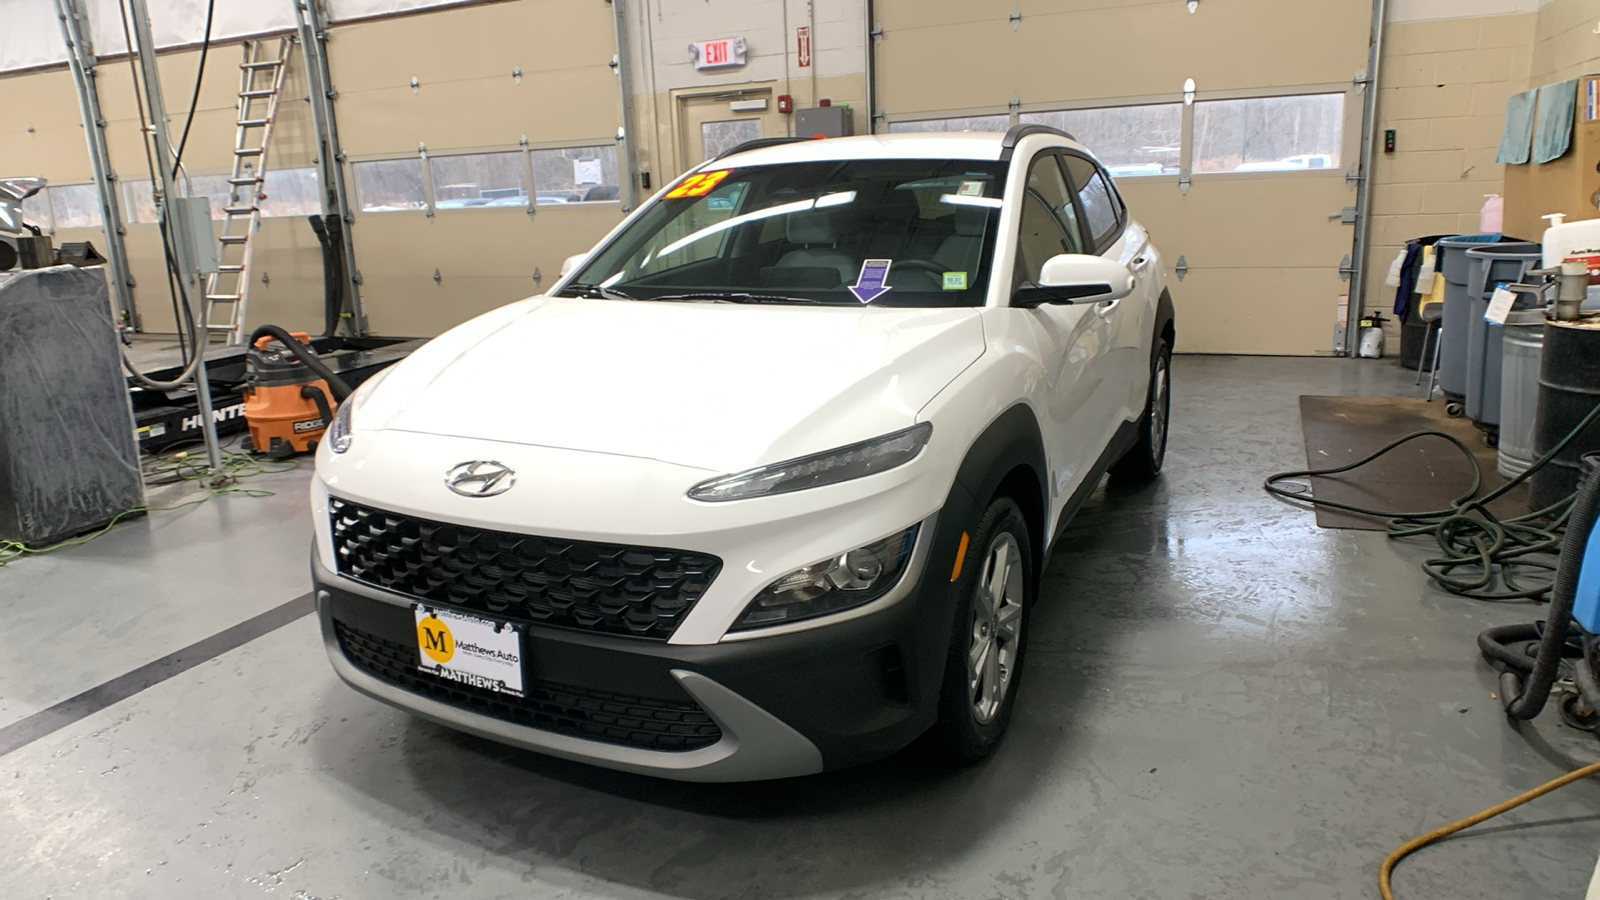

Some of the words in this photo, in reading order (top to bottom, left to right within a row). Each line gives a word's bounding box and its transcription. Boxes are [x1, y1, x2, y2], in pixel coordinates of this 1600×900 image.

[705, 41, 728, 64] EXIT
[665, 170, 730, 198] 23
[455, 639, 496, 657] Matthews
[496, 650, 519, 663] Auto
[440, 667, 500, 692] MATTHEWS
